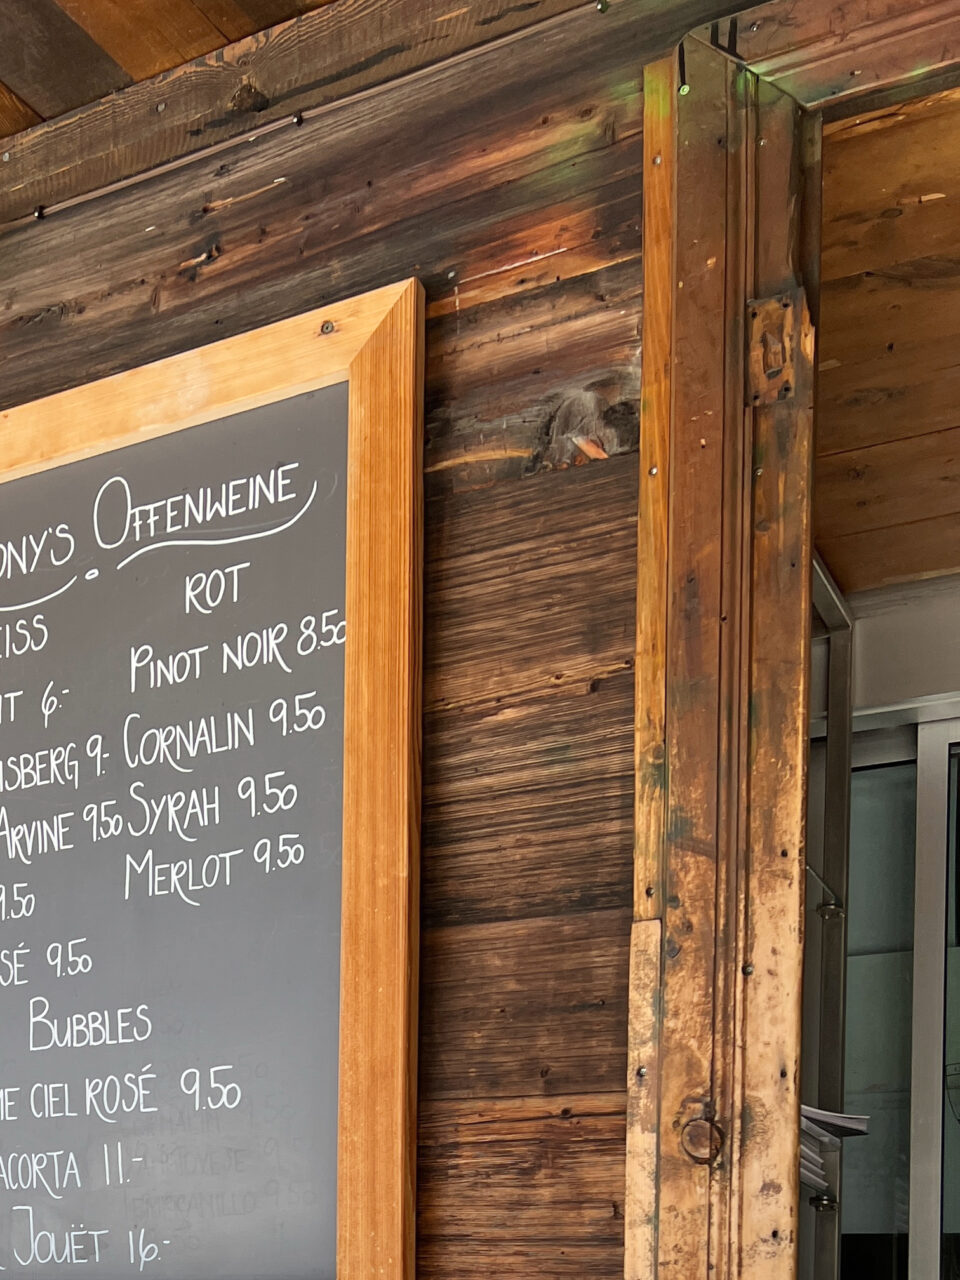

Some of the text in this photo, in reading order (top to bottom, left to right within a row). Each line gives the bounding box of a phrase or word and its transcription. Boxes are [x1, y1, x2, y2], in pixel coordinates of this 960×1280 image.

[93, 462, 300, 550] OFFENWEINE
[185, 561, 251, 615] ROT
[130, 608, 347, 694] PINOT NOIR 8.50
[123, 690, 326, 773] CORNALIN 9.50
[82, 799, 124, 843] 9.50
[127, 770, 298, 843] SYRAH 9.50
[124, 833, 305, 907] MERLOT 9.50
[46, 937, 93, 978] 9.50
[29, 996, 152, 1052] BUBBLES
[30, 1082, 78, 1119] CIEL
[85, 1063, 159, 1123] ROSÉ
[180, 1065, 242, 1111] 9.50
[12, 1205, 109, 1266] JOUËT
